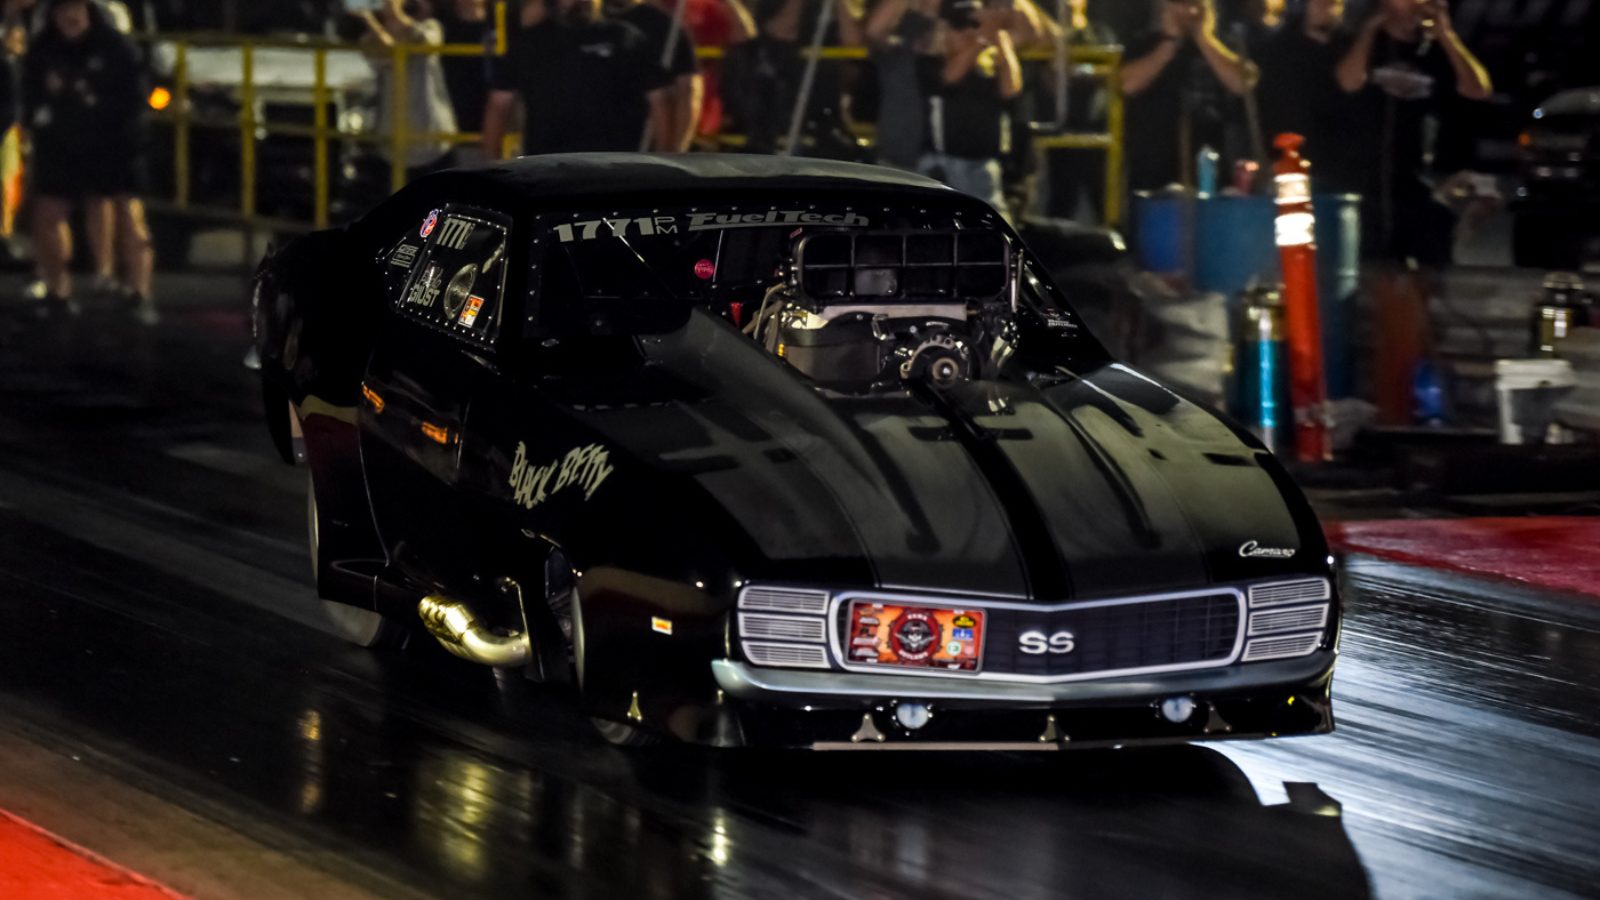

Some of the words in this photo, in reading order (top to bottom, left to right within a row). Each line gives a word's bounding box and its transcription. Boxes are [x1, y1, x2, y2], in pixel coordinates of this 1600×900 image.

[553, 217, 655, 243] 1771
[687, 210, 869, 230] FuelTech
[509, 440, 558, 510] BLACK
[551, 442, 614, 501] BETTY
[1239, 540, 1296, 558] Camaro
[1019, 630, 1075, 654] SS
